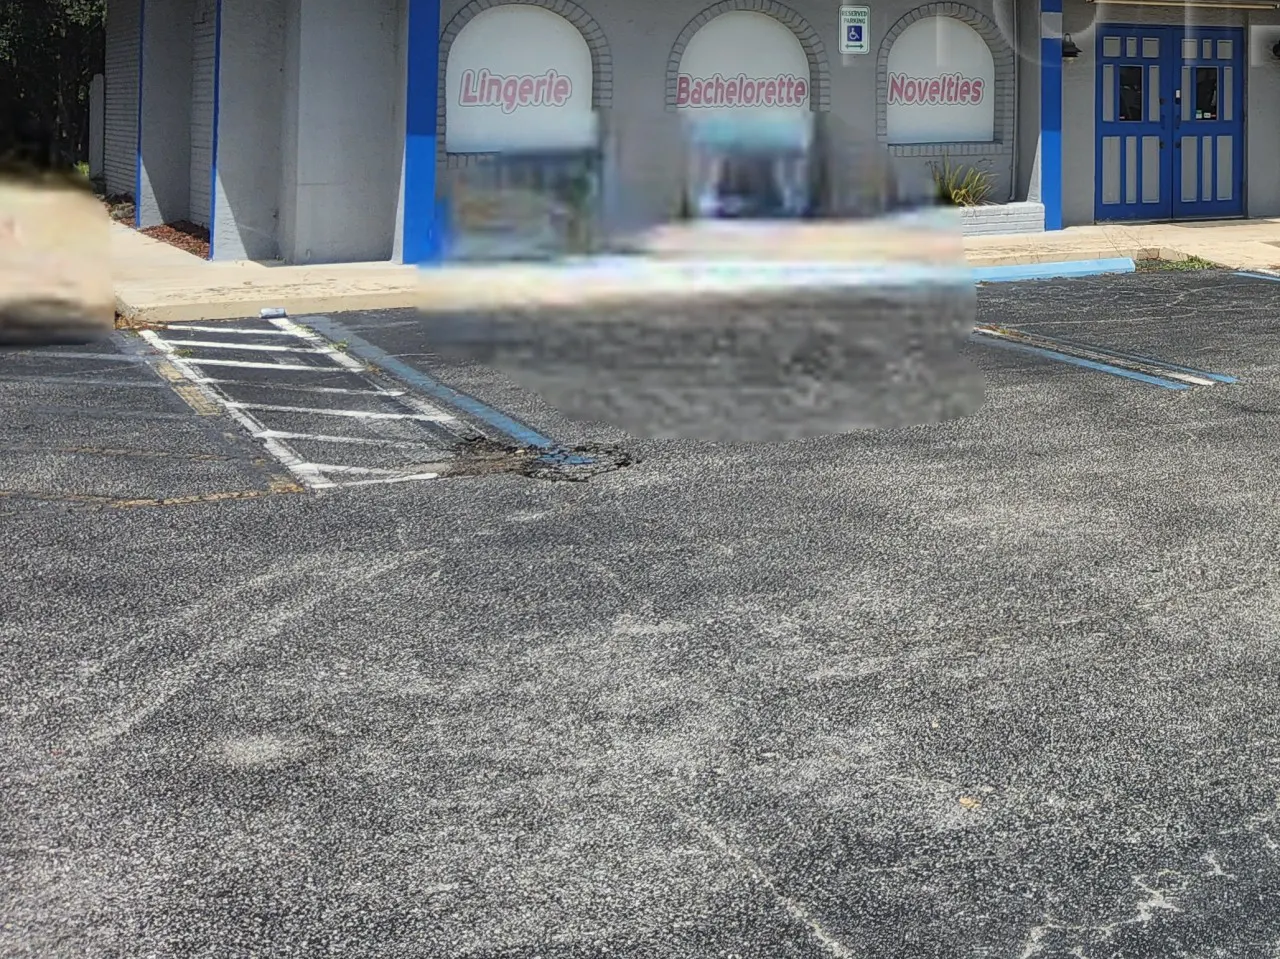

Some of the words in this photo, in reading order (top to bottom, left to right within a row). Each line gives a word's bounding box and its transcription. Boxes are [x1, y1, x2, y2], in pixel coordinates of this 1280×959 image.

[841, 10, 868, 18] RESERVED
[844, 18, 866, 26] PARKING
[461, 70, 570, 112] Lingerie
[677, 75, 806, 106] Bachelorette
[888, 74, 983, 103] Novelties
